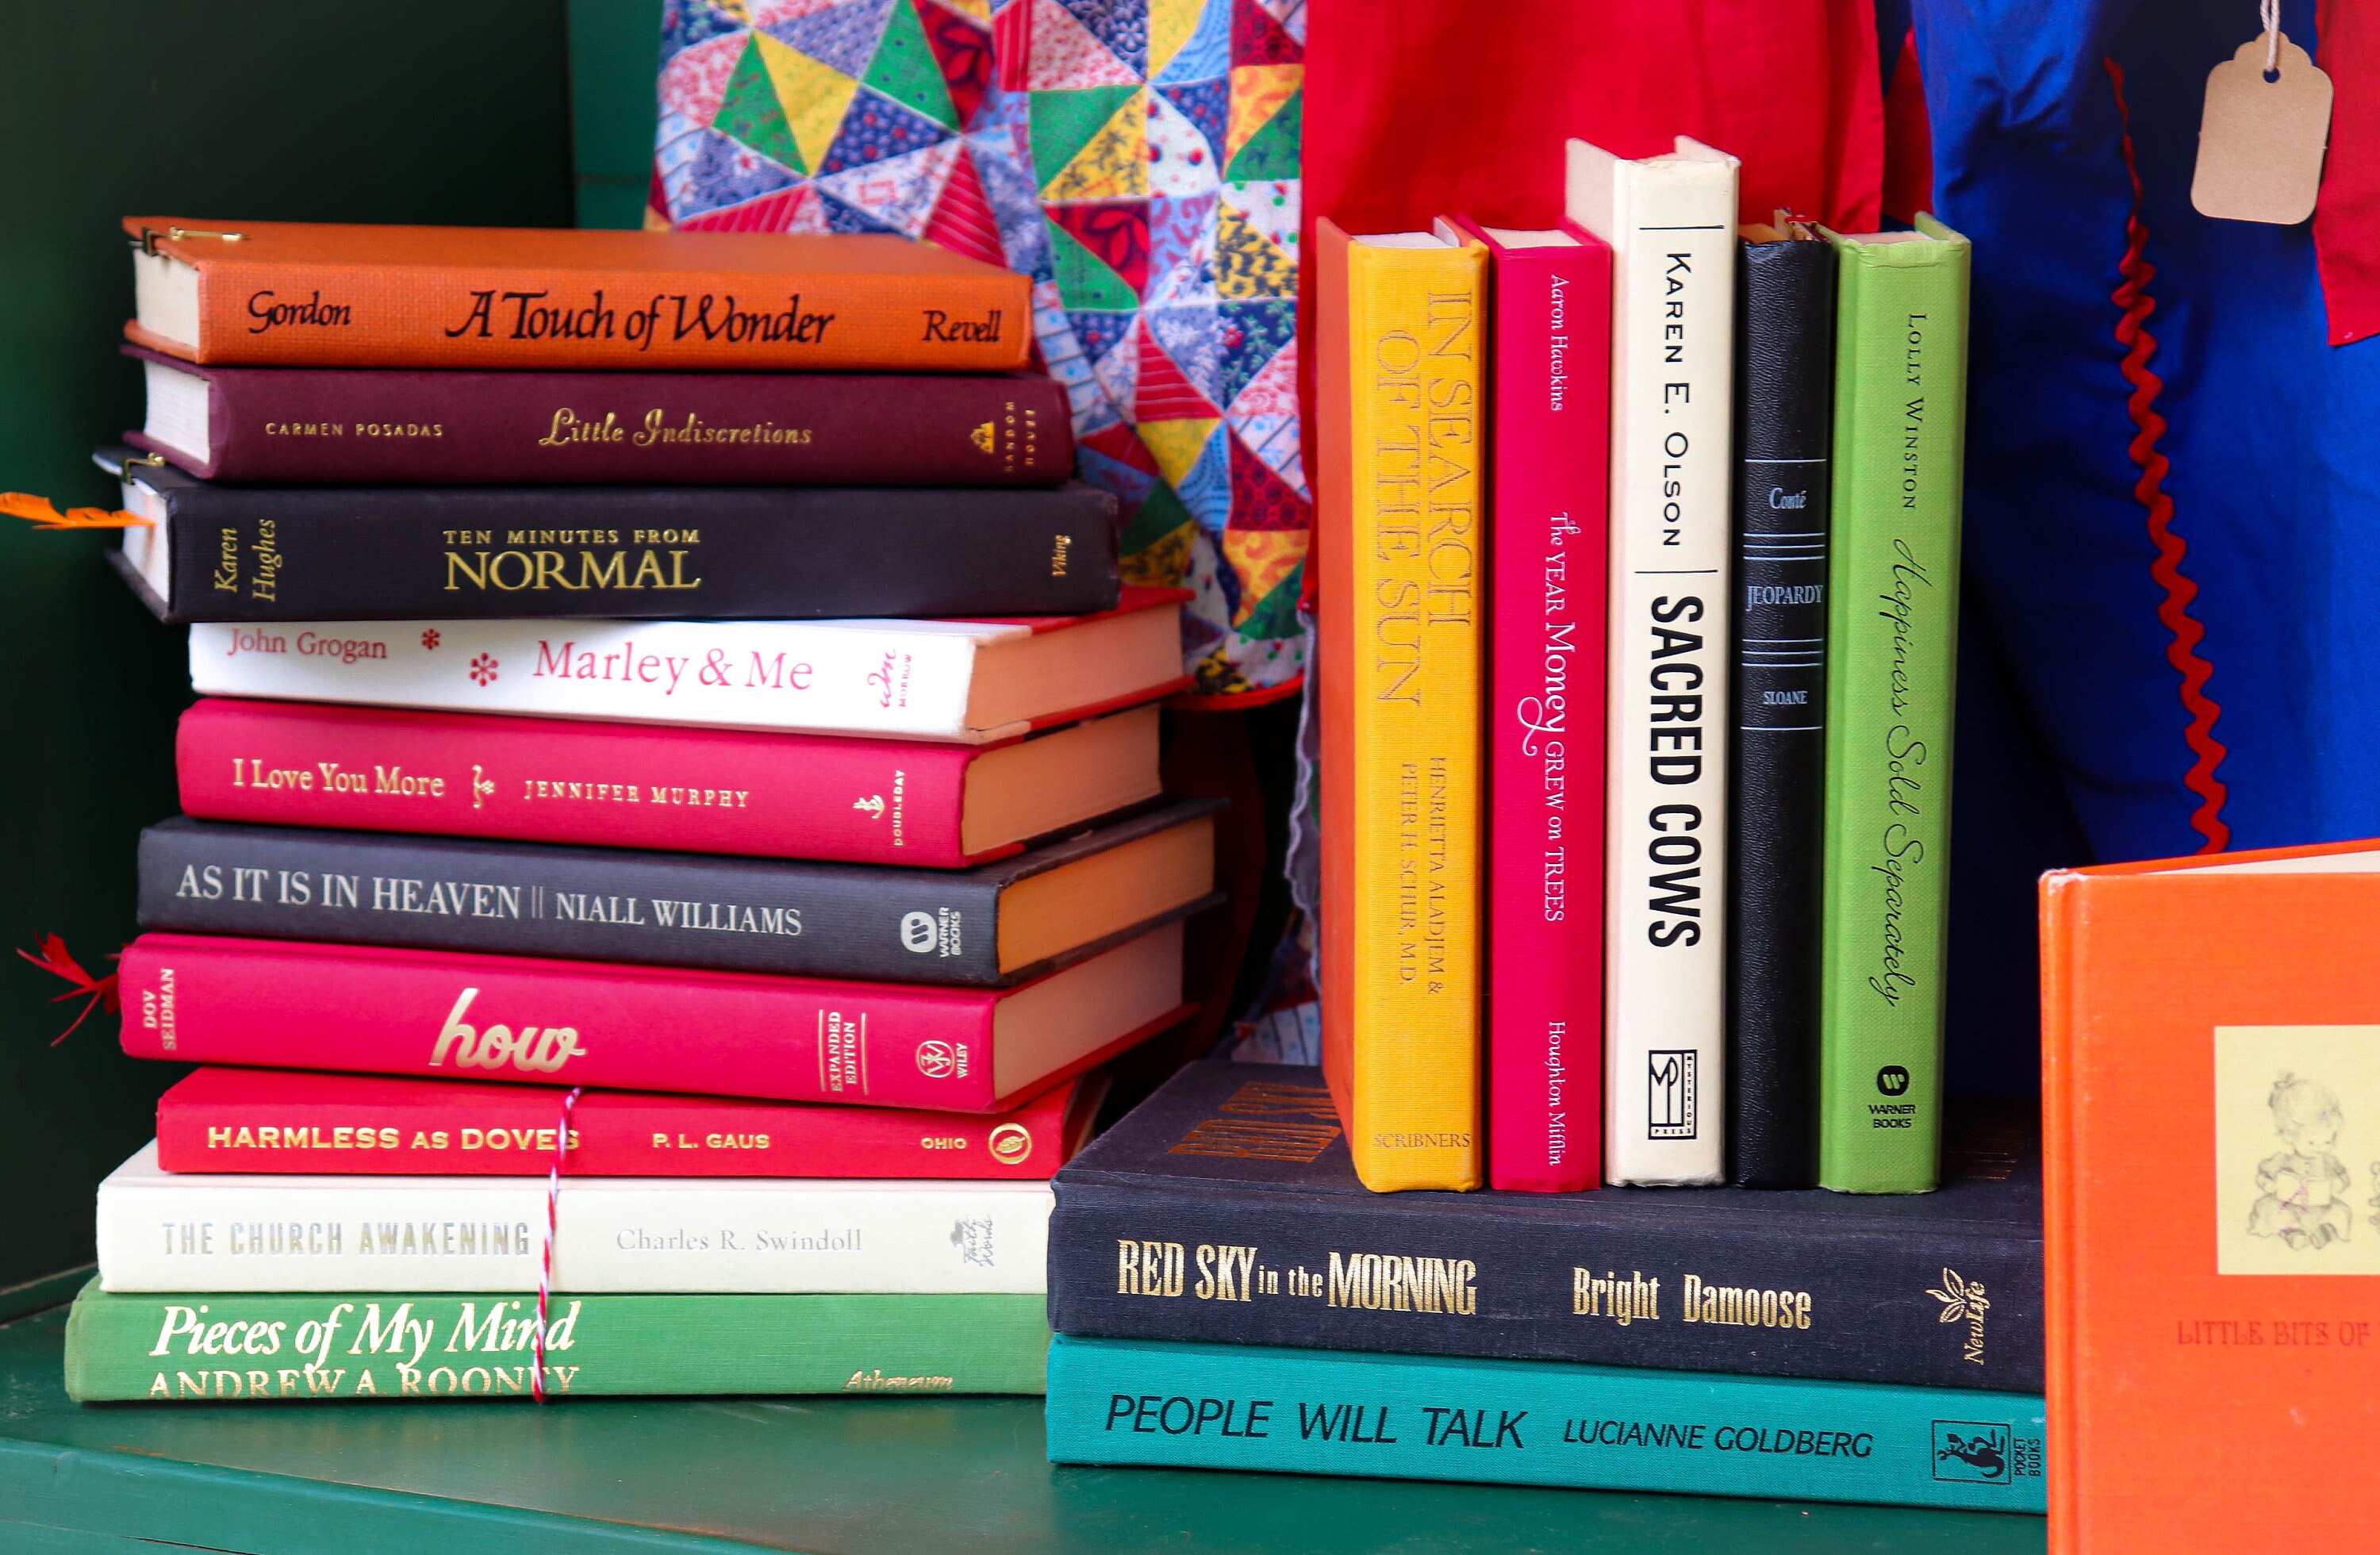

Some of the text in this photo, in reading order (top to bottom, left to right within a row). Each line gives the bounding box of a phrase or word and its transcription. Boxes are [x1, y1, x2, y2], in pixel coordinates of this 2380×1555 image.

[248, 291, 351, 332] Gordon
[445, 290, 835, 351] A Touch of Wonder
[922, 310, 1002, 343] Revell
[1549, 275, 1570, 411] Aaron Hawkins
[1662, 252, 1691, 547] KAREN E. OLSON
[1904, 313, 1925, 509] LOLLY WINSTON
[266, 422, 442, 437] CARMEN POSADAS
[538, 407, 812, 446] Little Indiscretions
[1429, 289, 1473, 627] IN SEARCH
[443, 529, 700, 544] TEN MINUTES FROM
[1376, 329, 1421, 706] OF THE SUN
[214, 528, 237, 593] Karen
[251, 518, 282, 602] Hughes
[443, 550, 701, 590] NORMAL
[1051, 533, 1072, 578] Viking
[1747, 585, 1823, 612] JEOPARDY
[228, 628, 387, 664] John Grogan
[532, 640, 814, 695] Marley & Me
[899, 653, 913, 708] MORROW
[1763, 691, 1807, 705] SLOANE
[1518, 511, 1581, 922] The YEAR Money GREW on TREES
[233, 758, 445, 797] I Love You More
[524, 779, 749, 808] JENNIFER MURPHY
[1648, 596, 1703, 947] SACRED COWS
[1868, 538, 1933, 1007] Happiness Sold Separately
[892, 769, 905, 847] DOUBLEDAY
[175, 865, 521, 919] AS IT IS IN HEAVEN
[1399, 762, 1418, 985] PETER H. SCHUR, M.D.
[1427, 757, 1449, 995] HENRIETTA ALADJEM &
[555, 892, 802, 936] NIALL WILLIAMS
[950, 912, 962, 955] BOOKS
[143, 990, 158, 1029] DOV
[162, 968, 176, 1051] SEIDMAN
[429, 986, 587, 1072] how
[828, 1011, 842, 1092] EXPANDED
[845, 1021, 856, 1085] EDITION
[956, 1042, 968, 1078] WILEY
[1544, 1021, 1566, 1166] Houghton Mifflin
[1868, 1104, 1917, 1114] WARNER
[208, 1127, 578, 1150] HARMLESS AS DOVES
[652, 1133, 770, 1150] P. L. GAUS
[920, 1137, 967, 1150] OHIO
[1373, 1132, 1470, 1149] SCRIBNERS
[1874, 1119, 1912, 1128] BOOKS
[163, 1223, 530, 1255] THE CHURCH AWAKENING
[616, 1229, 862, 1251] Charles R. Swindoll
[1117, 1239, 1477, 1315] RED SKY in the MORNING
[1572, 1267, 1812, 1329] Bright Damoose
[148, 1301, 582, 1370] Pieces of My Mind
[2178, 1321, 2370, 1346] LITTLE BITS OF
[149, 1370, 346, 1398] ANDREW
[1105, 1395, 1528, 1449] PEOPLE WILL TALK
[1564, 1419, 1874, 1458] LUCIANNE GOLDBERG
[2014, 1436, 2026, 1476] POCKET
[2028, 1438, 2041, 1476] BOOKS
